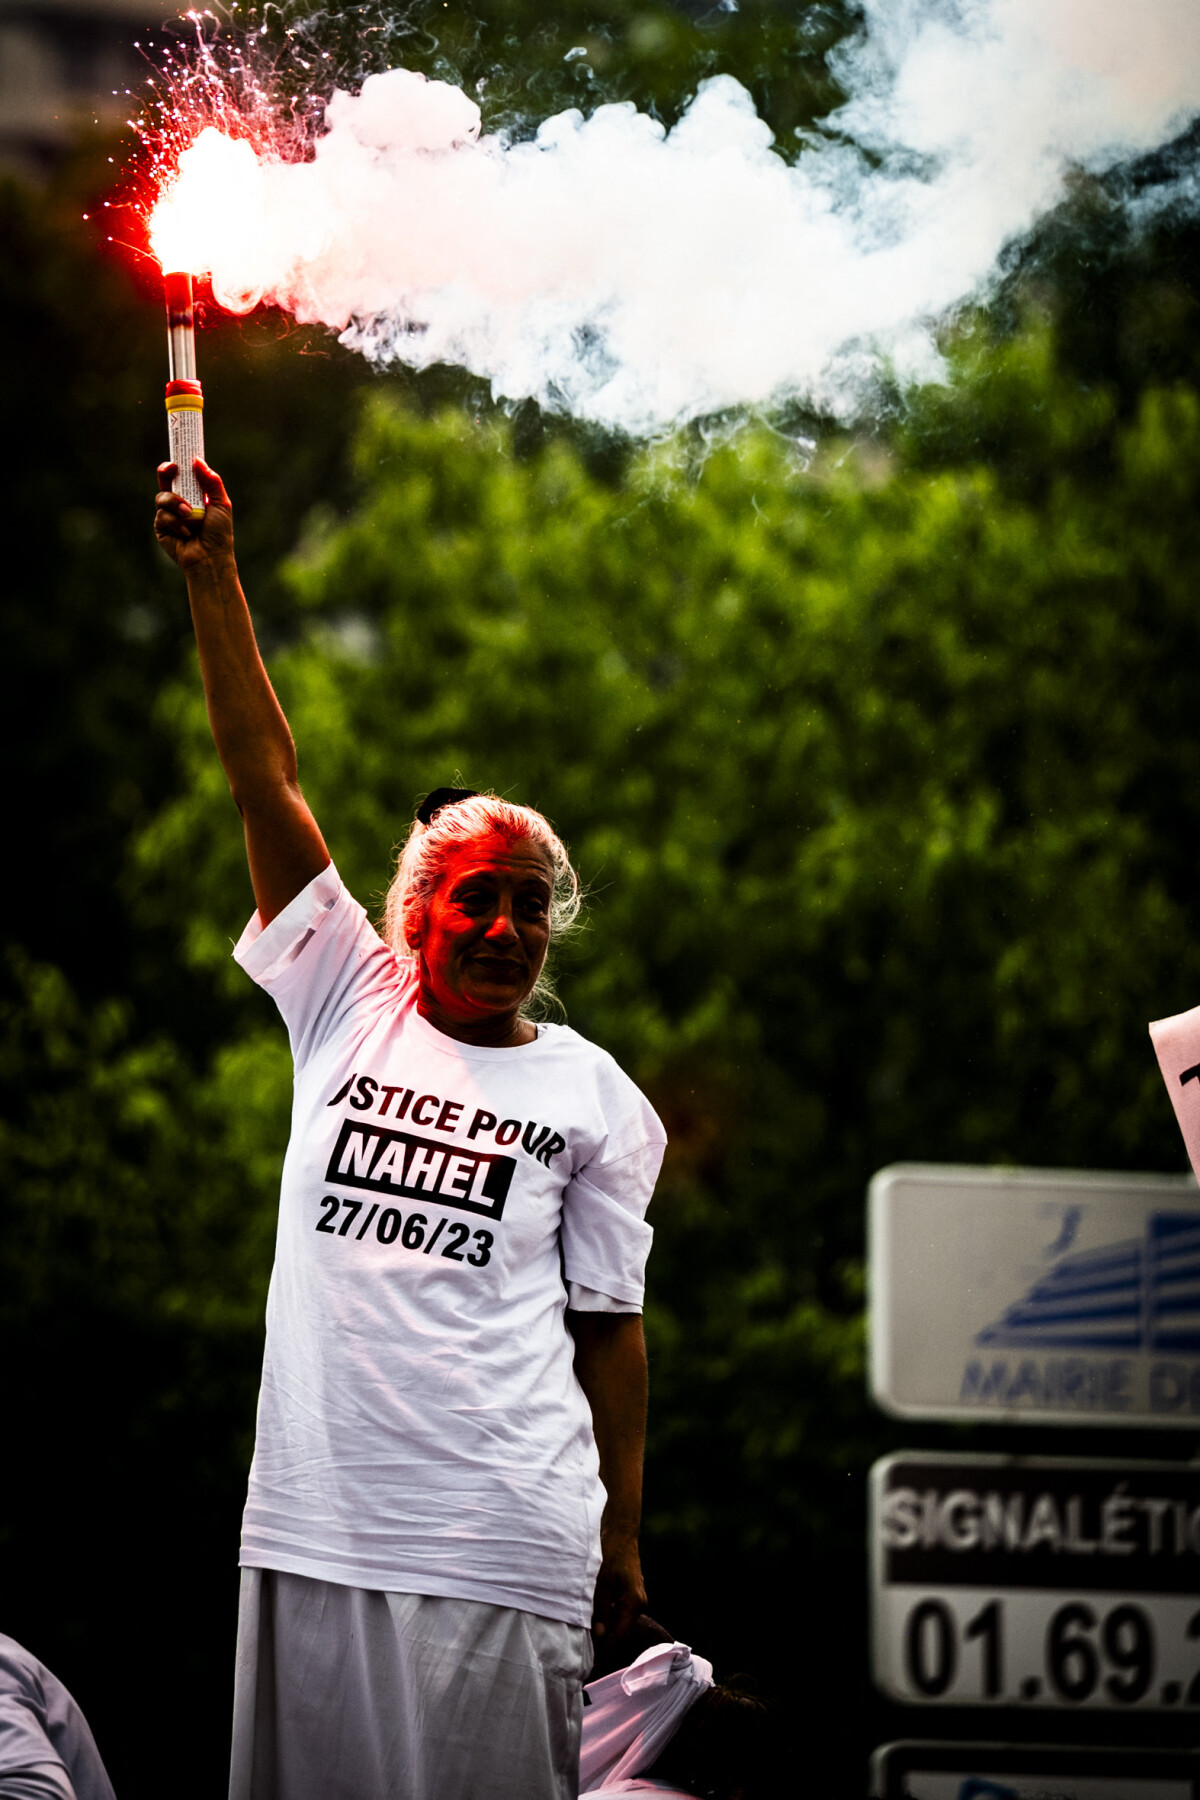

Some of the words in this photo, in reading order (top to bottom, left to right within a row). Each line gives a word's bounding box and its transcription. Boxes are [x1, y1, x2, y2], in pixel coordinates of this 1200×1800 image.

[337, 1130, 496, 1208] NAHEL
[466, 1108, 566, 1169] POUR
[315, 1195, 495, 1268] 27/06/23
[958, 1357, 1133, 1410] MAIRIE
[1148, 1360, 1200, 1414] D
[903, 1596, 1200, 1705] 01.69.
